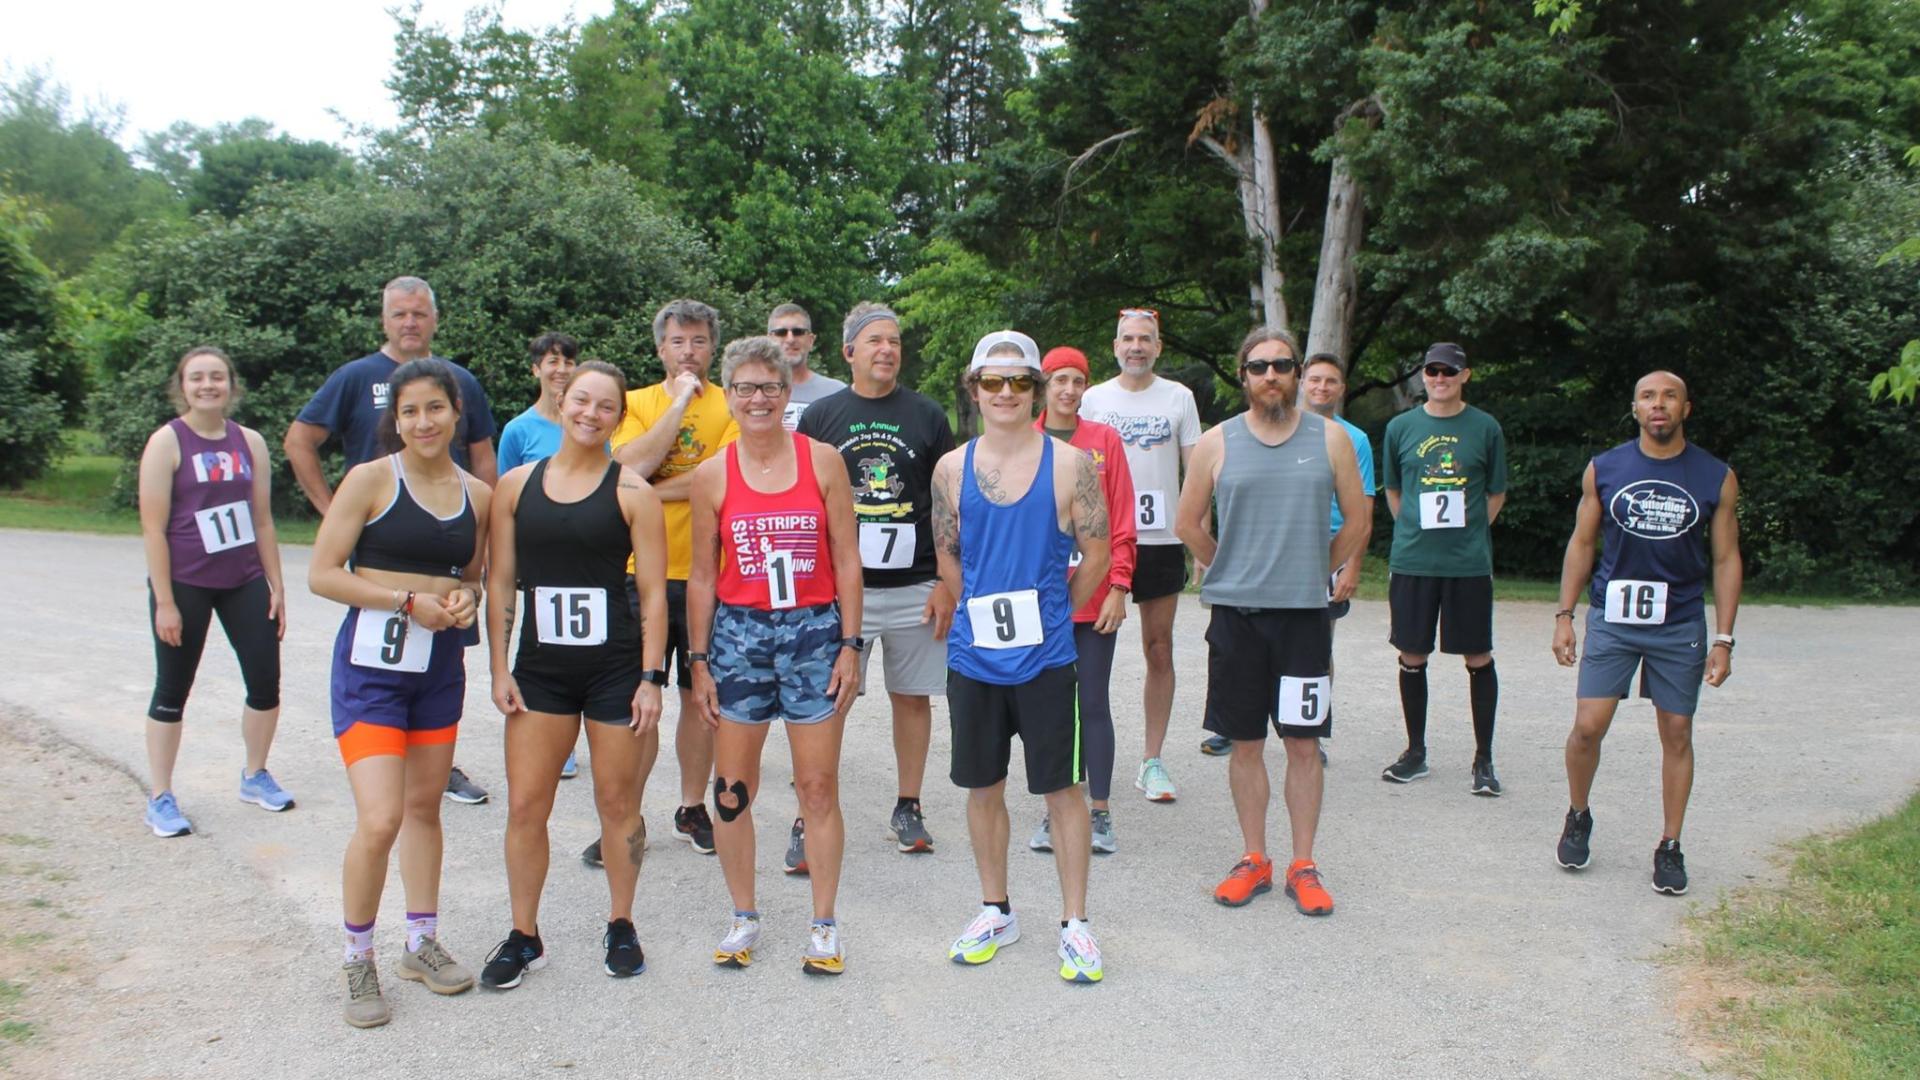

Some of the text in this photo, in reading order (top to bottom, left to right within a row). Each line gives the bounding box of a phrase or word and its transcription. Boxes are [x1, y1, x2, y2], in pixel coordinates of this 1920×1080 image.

[849, 421, 900, 433] 8th Annual
[209, 507, 240, 545] 11
[756, 515, 817, 531] STRIPES
[1140, 494, 1155, 525] 3
[1435, 494, 1450, 523] 2
[731, 519, 756, 576] STARS
[880, 527, 898, 564] 7
[771, 556, 787, 601] 1
[550, 593, 591, 639] 15
[992, 597, 1016, 642] 9
[1620, 584, 1654, 620] 16
[381, 617, 408, 665] 9
[1301, 682, 1319, 721] 5
